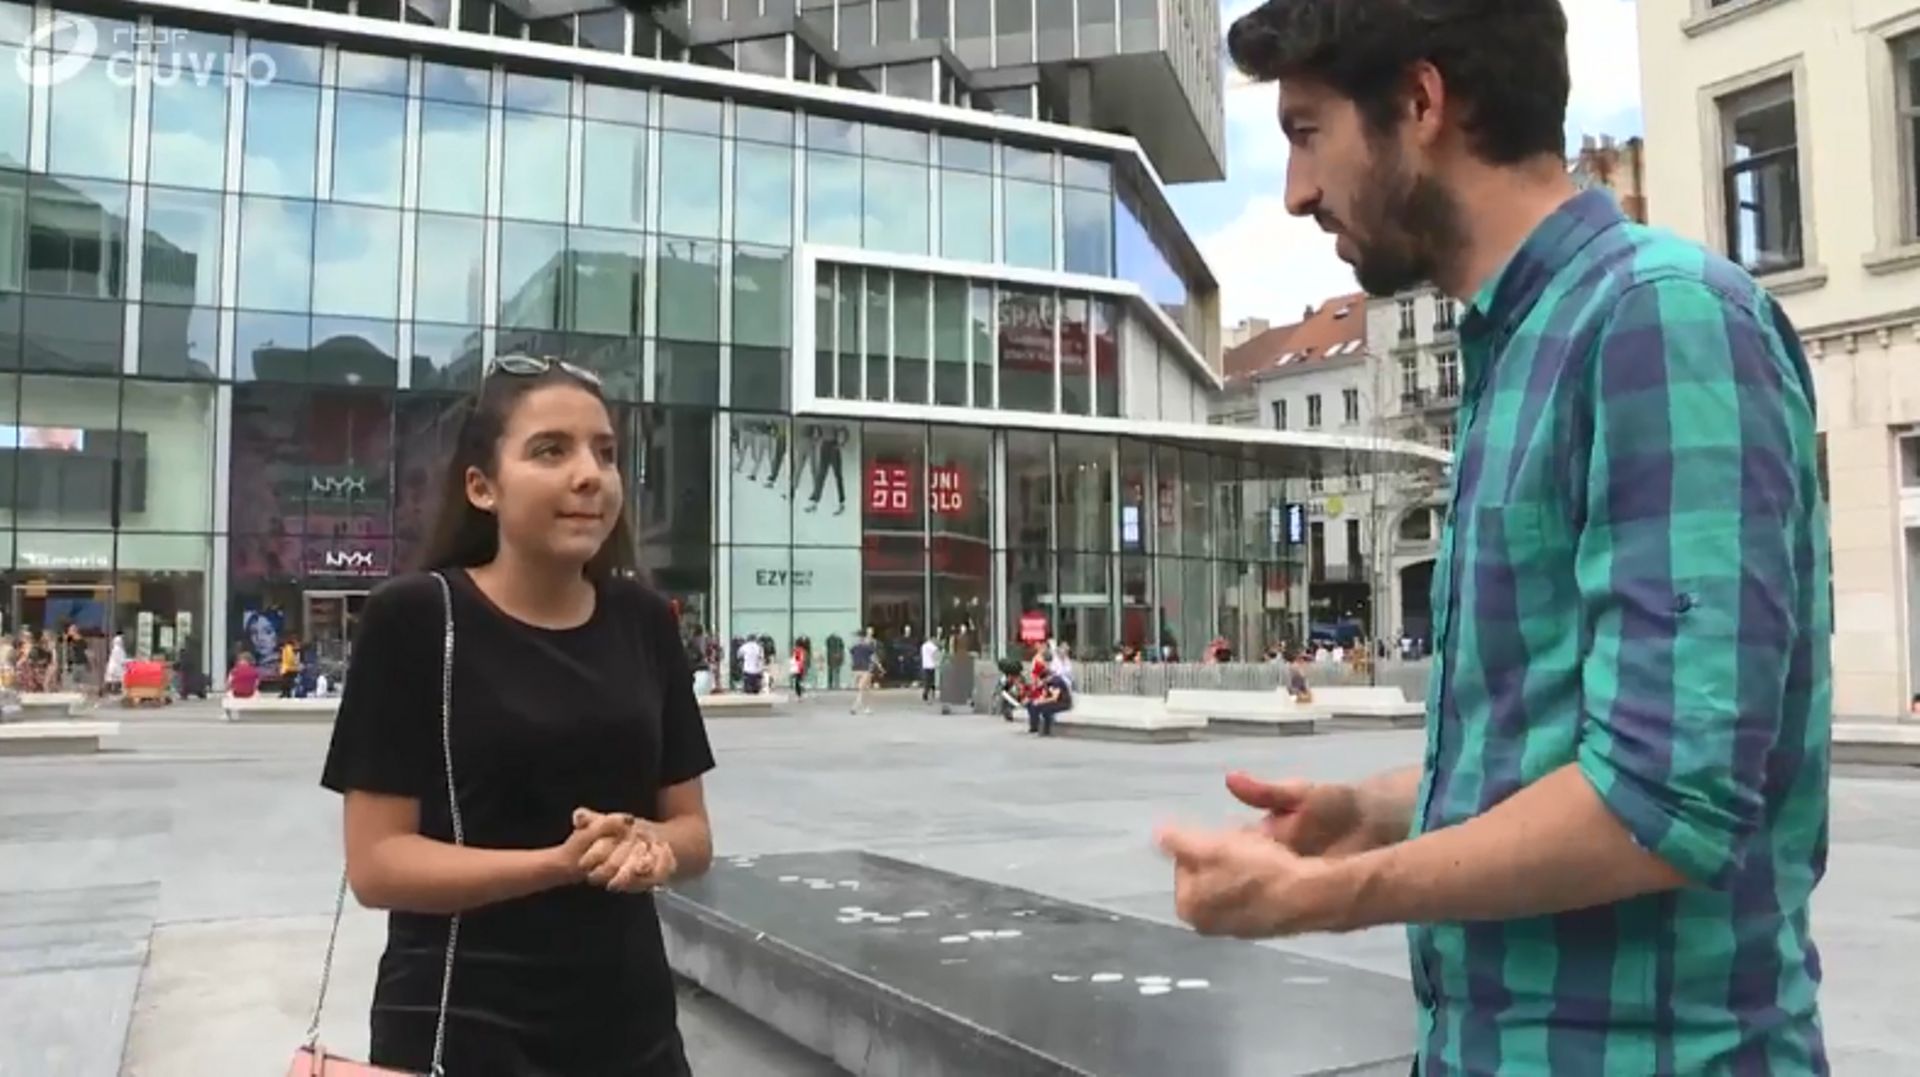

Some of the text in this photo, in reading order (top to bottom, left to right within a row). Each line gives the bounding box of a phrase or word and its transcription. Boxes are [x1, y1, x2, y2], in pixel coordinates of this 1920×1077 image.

[312, 476, 365, 496] NYX
[930, 472, 959, 489] UNI
[325, 550, 373, 567] NYX
[756, 569, 787, 586] EZY
